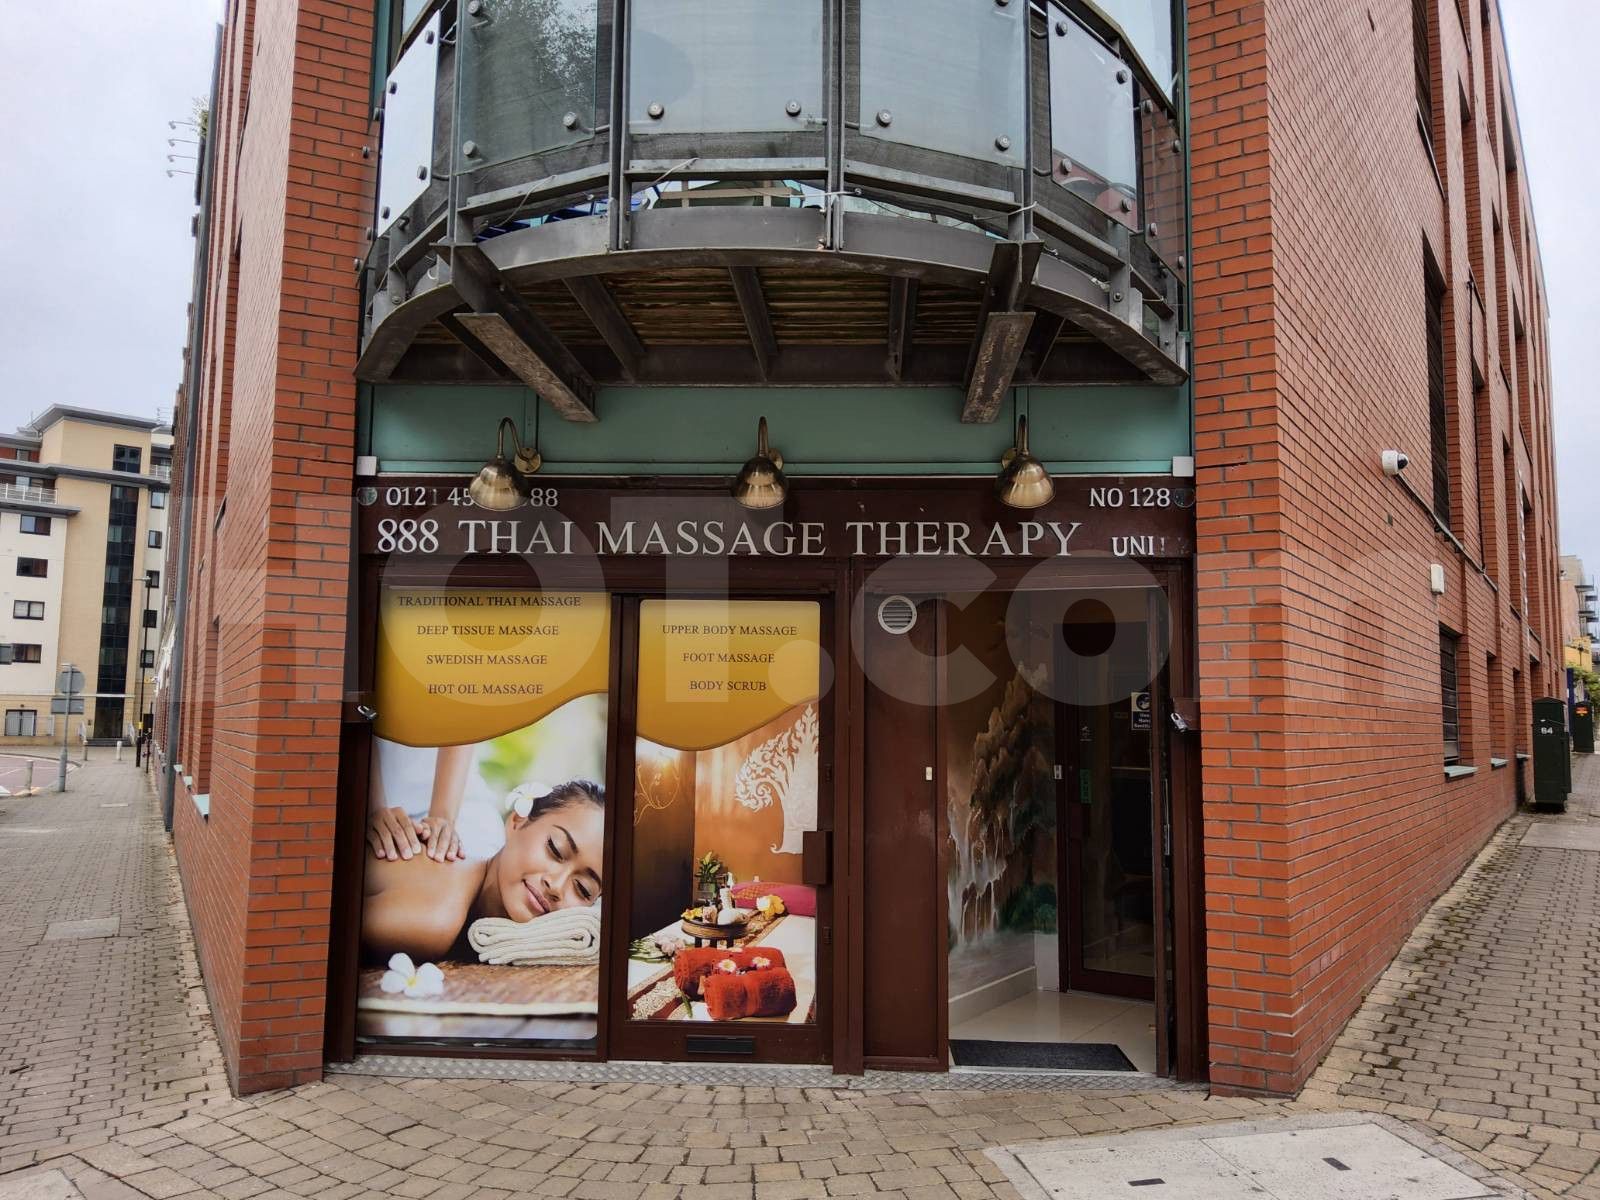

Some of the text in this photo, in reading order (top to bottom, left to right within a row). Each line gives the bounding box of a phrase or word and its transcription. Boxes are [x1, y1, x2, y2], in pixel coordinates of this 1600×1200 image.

[447, 487, 475, 506] 45
[1089, 487, 1170, 507] NO 128
[377, 518, 1082, 556] 888 THAI MASSAGE THERAPY
[398, 596, 581, 607] TRADITIONAL THAI MASSAGE
[417, 625, 559, 636] DEEP TISSUE MASSAGE
[662, 624, 798, 636] UPPER BODY MASSAGE
[426, 655, 548, 665] SWEDISH MASSAGE
[683, 652, 776, 664] FOOT MASSAGE
[428, 684, 544, 694] HOT OIL MASSAGE
[690, 680, 768, 692] BODY SCRUB
